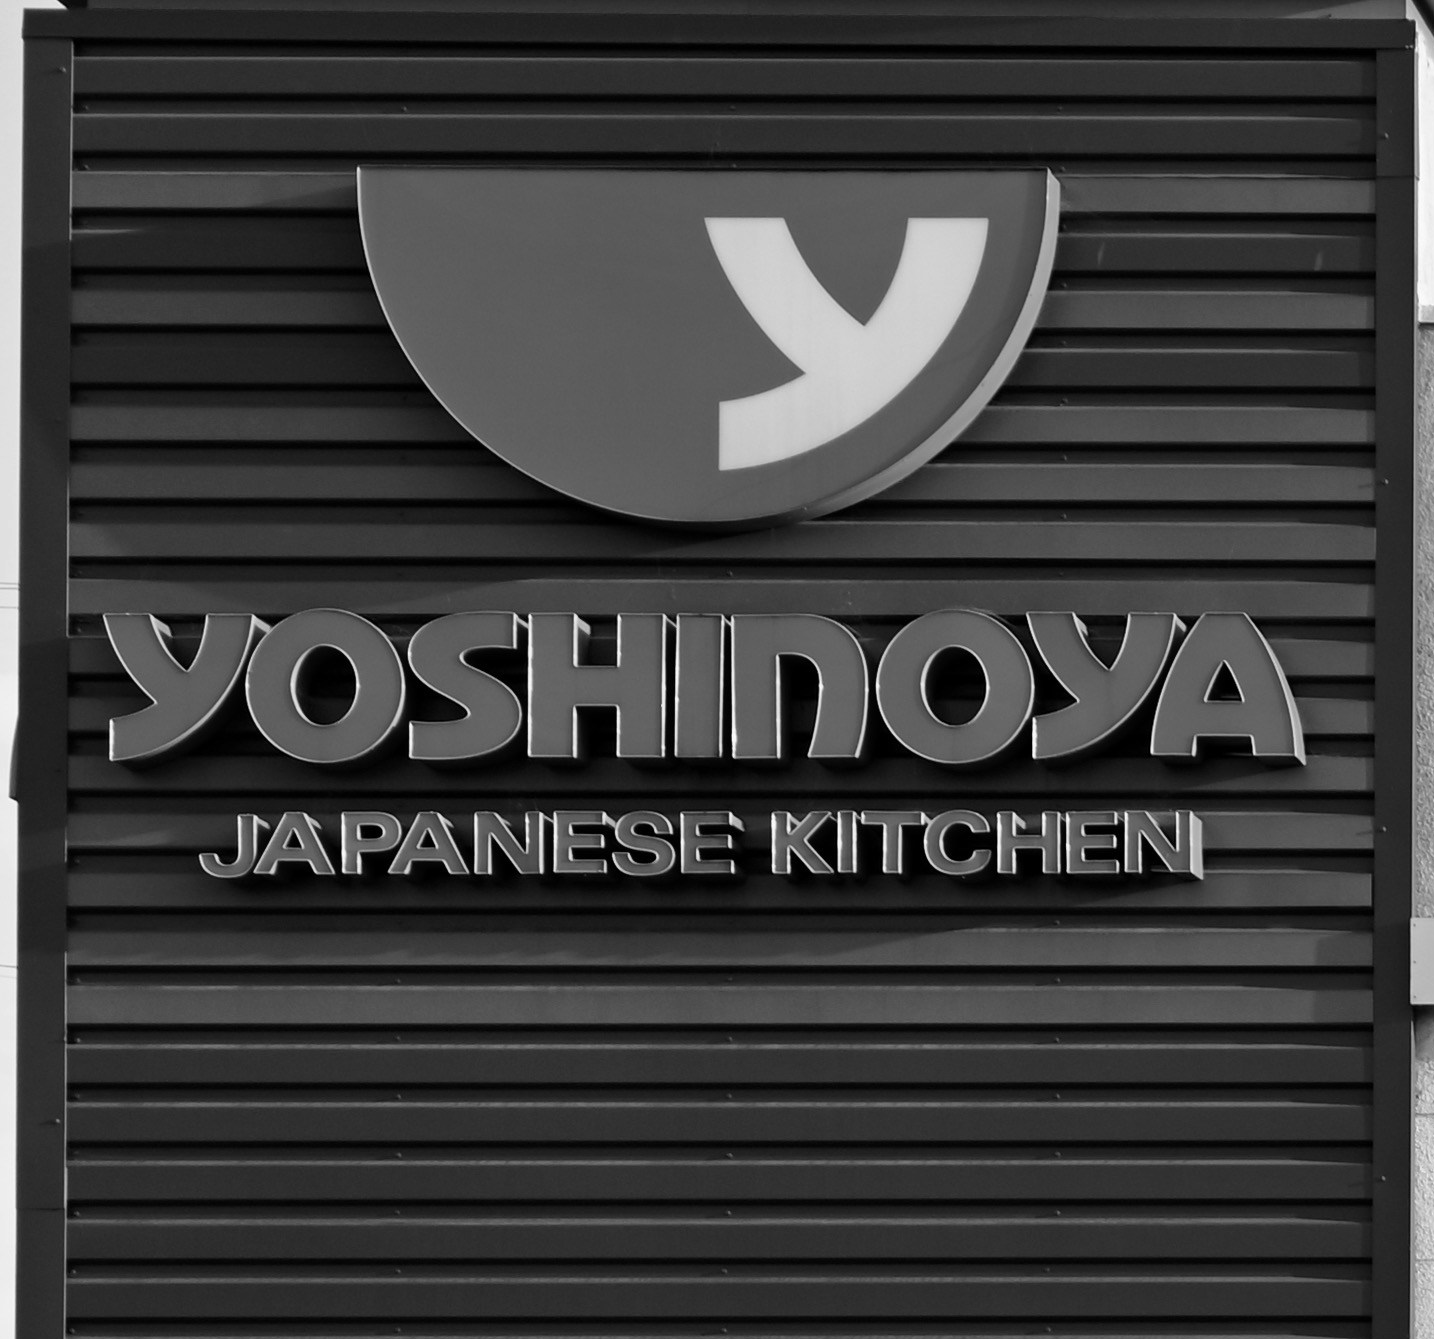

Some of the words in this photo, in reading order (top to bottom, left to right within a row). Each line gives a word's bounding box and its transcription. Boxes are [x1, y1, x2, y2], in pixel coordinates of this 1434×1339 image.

[103, 608, 1306, 765] YOSHINOYA
[199, 810, 746, 878] JAPANESE
[770, 810, 1205, 880] KITCHEN
